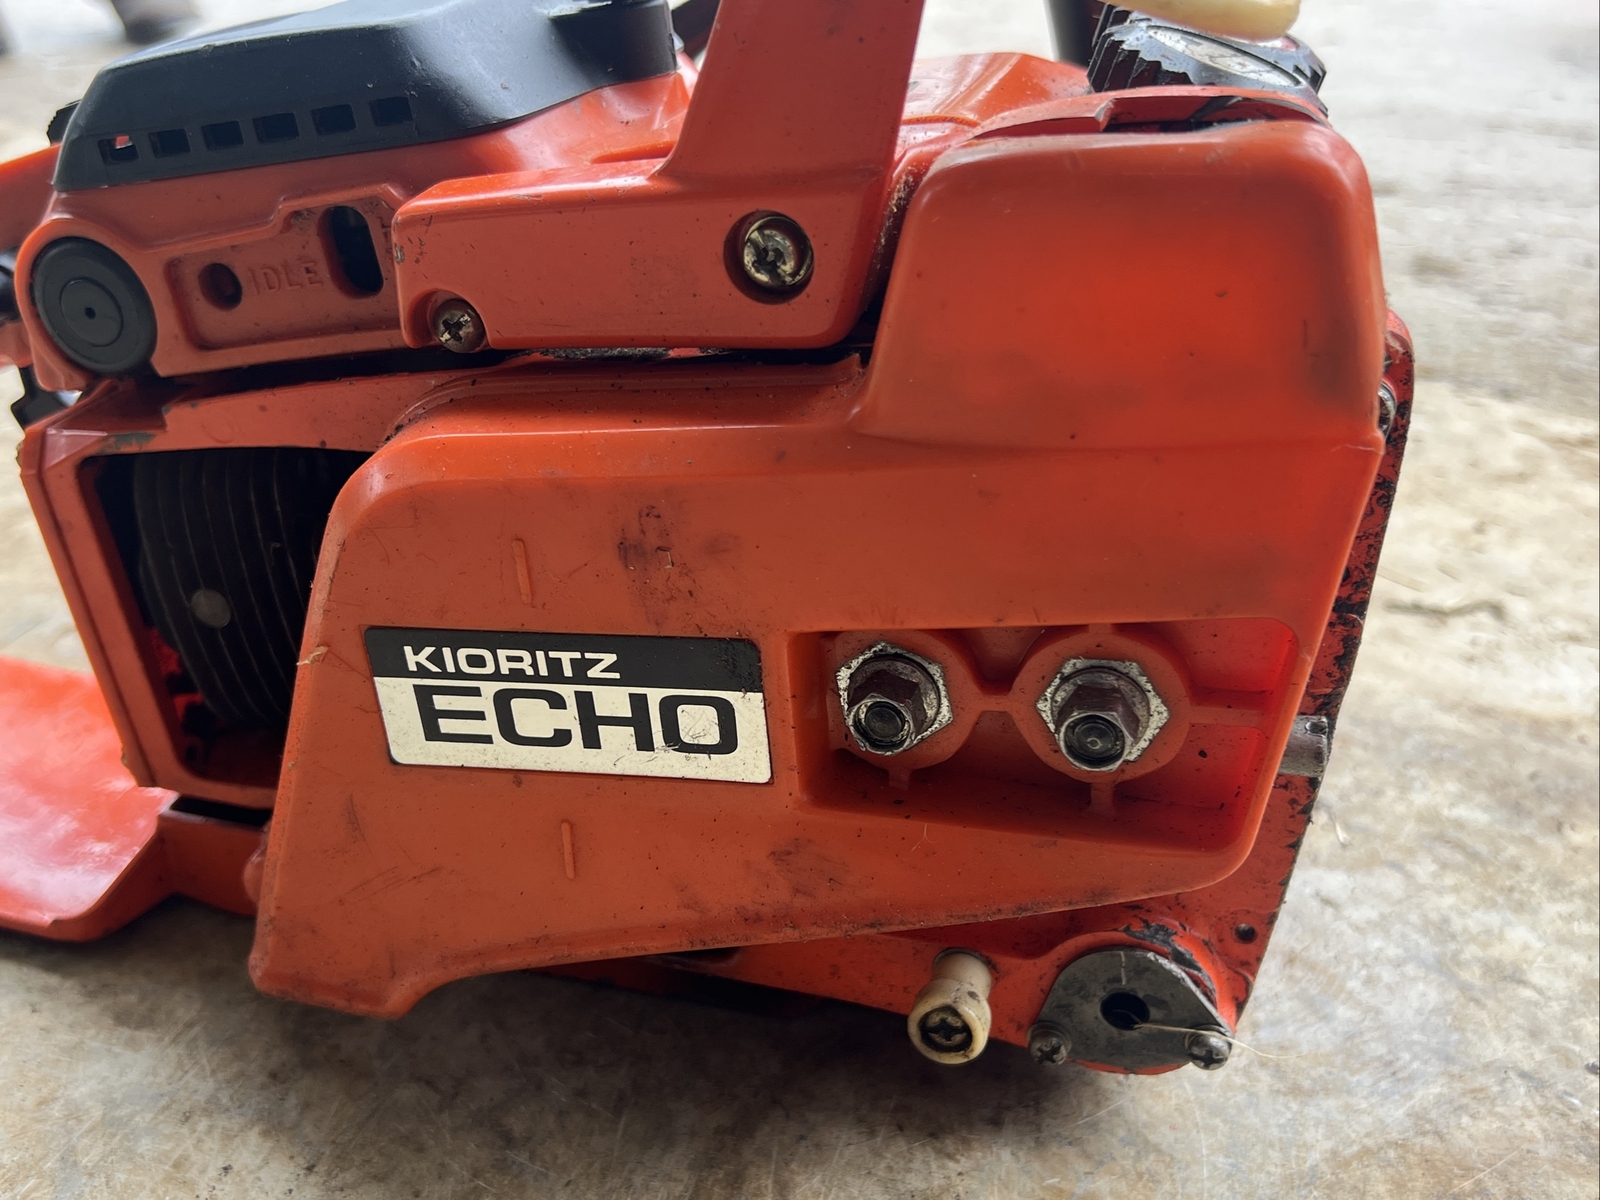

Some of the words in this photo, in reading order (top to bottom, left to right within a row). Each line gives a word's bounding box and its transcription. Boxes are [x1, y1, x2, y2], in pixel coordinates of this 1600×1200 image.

[248, 260, 323, 296] IDLE
[403, 645, 621, 679] KIORITZ
[412, 684, 738, 755] ECHO
